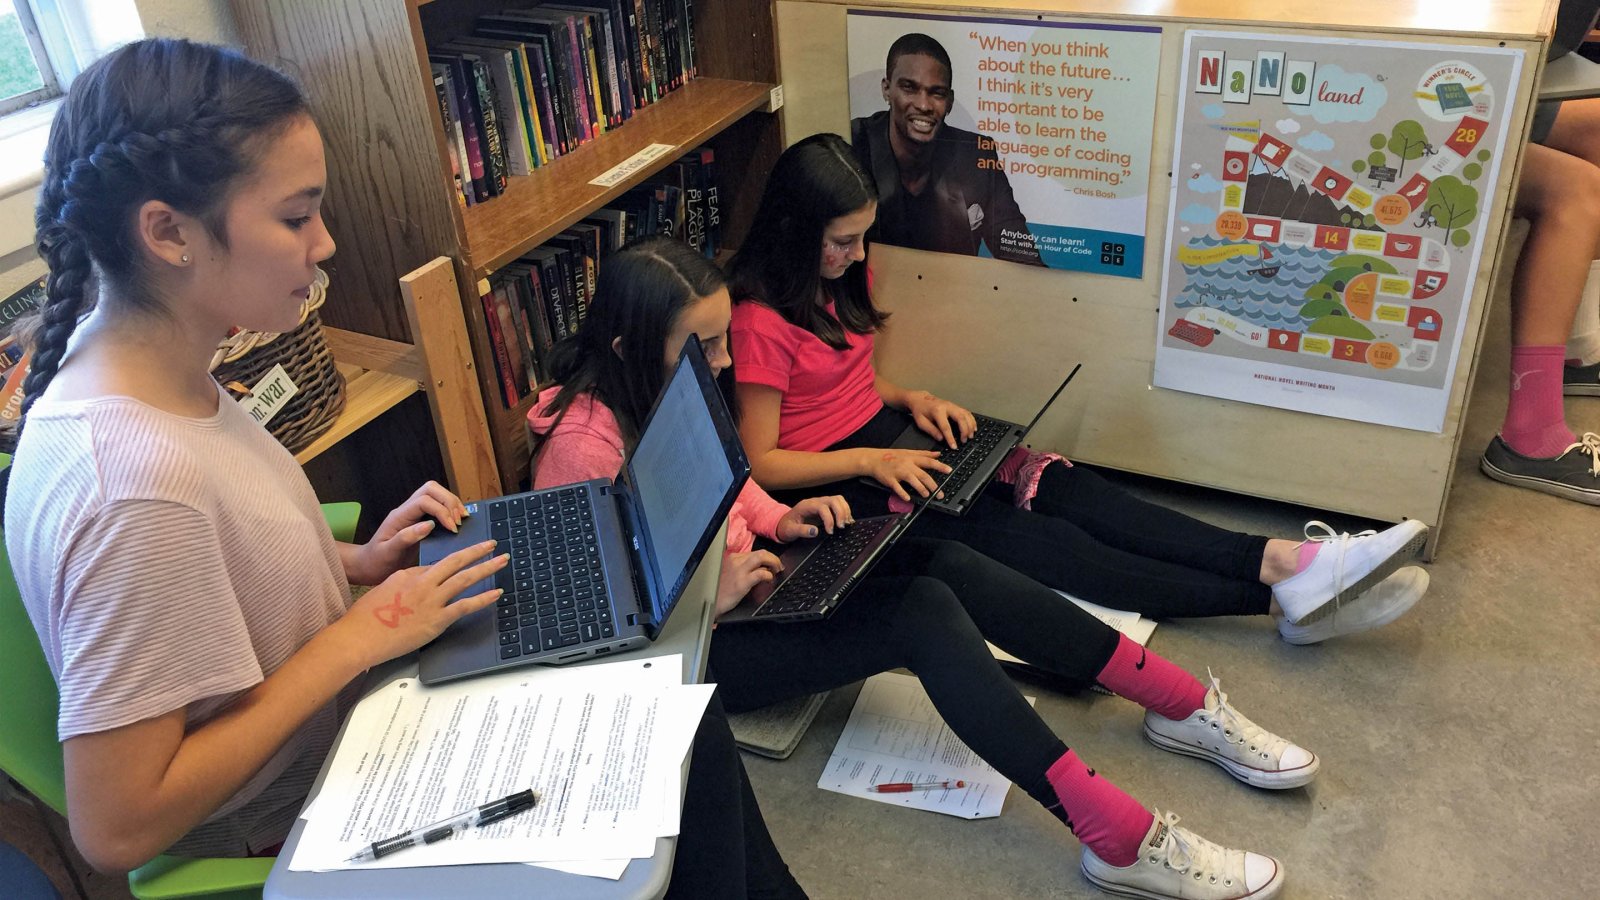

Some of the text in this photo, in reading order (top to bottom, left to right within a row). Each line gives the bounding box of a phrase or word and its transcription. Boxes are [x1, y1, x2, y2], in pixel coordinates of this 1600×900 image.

[970, 32, 1109, 58] “When you think
[978, 57, 1025, 74] about
[1030, 60, 1056, 76] the
[978, 77, 982, 90] I
[986, 77, 1026, 94] think
[1057, 86, 1093, 102] very
[1318, 80, 1364, 105] land
[978, 97, 1104, 121] important to be
[486, 126, 496, 155] FALLOUT
[977, 118, 1107, 142] able to learn the
[1456, 128, 1477, 143] 28
[977, 136, 1131, 167] language of coding
[977, 158, 1006, 170] and
[1073, 187, 1093, 196] Chris
[1095, 189, 1116, 199] Bosh
[697, 190, 706, 243] PLAGUE
[708, 186, 719, 227] FEAR
[1000, 228, 1086, 246] Anybody can learn!
[1001, 237, 1016, 246] Start
[1017, 240, 1033, 248] with
[1044, 244, 1061, 253] Hour
[1072, 247, 1092, 256] Code
[1324, 231, 1339, 244] 14
[574, 267, 586, 321] BLACKOU
[1250, 332, 1262, 341] GO!
[1345, 344, 1354, 356] 3
[258, 377, 286, 407] war
[1254, 373, 1336, 391] NATIONAL NOVEL WRITING MONTH
